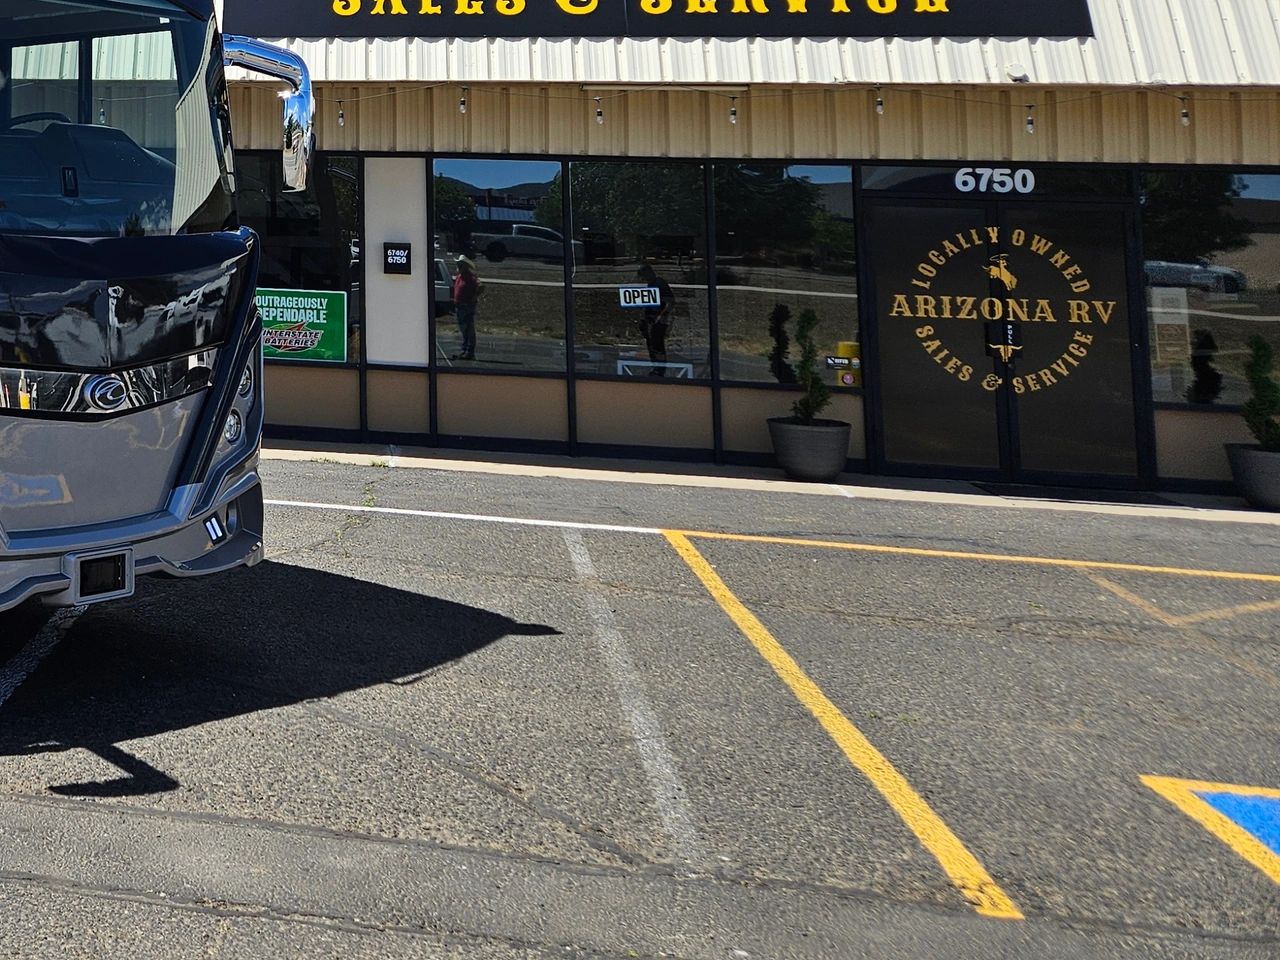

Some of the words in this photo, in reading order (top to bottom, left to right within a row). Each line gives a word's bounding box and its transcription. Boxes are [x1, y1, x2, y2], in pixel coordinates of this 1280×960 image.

[954, 167, 1035, 193] 6750
[387, 256, 407, 264] 6750
[911, 226, 1000, 290] LOCALLY
[1011, 228, 1091, 293] OWNED
[255, 295, 328, 309] OUTRAGEOUSLY
[623, 289, 657, 305] OPEN
[889, 294, 1057, 322] ARIZONA
[1067, 299, 1116, 324] RV
[263, 329, 321, 339] INTERSTATE
[264, 338, 317, 347] BATTERIES
[915, 324, 974, 382] SALES
[980, 373, 1003, 391] &
[1012, 330, 1094, 394] SERVICE
